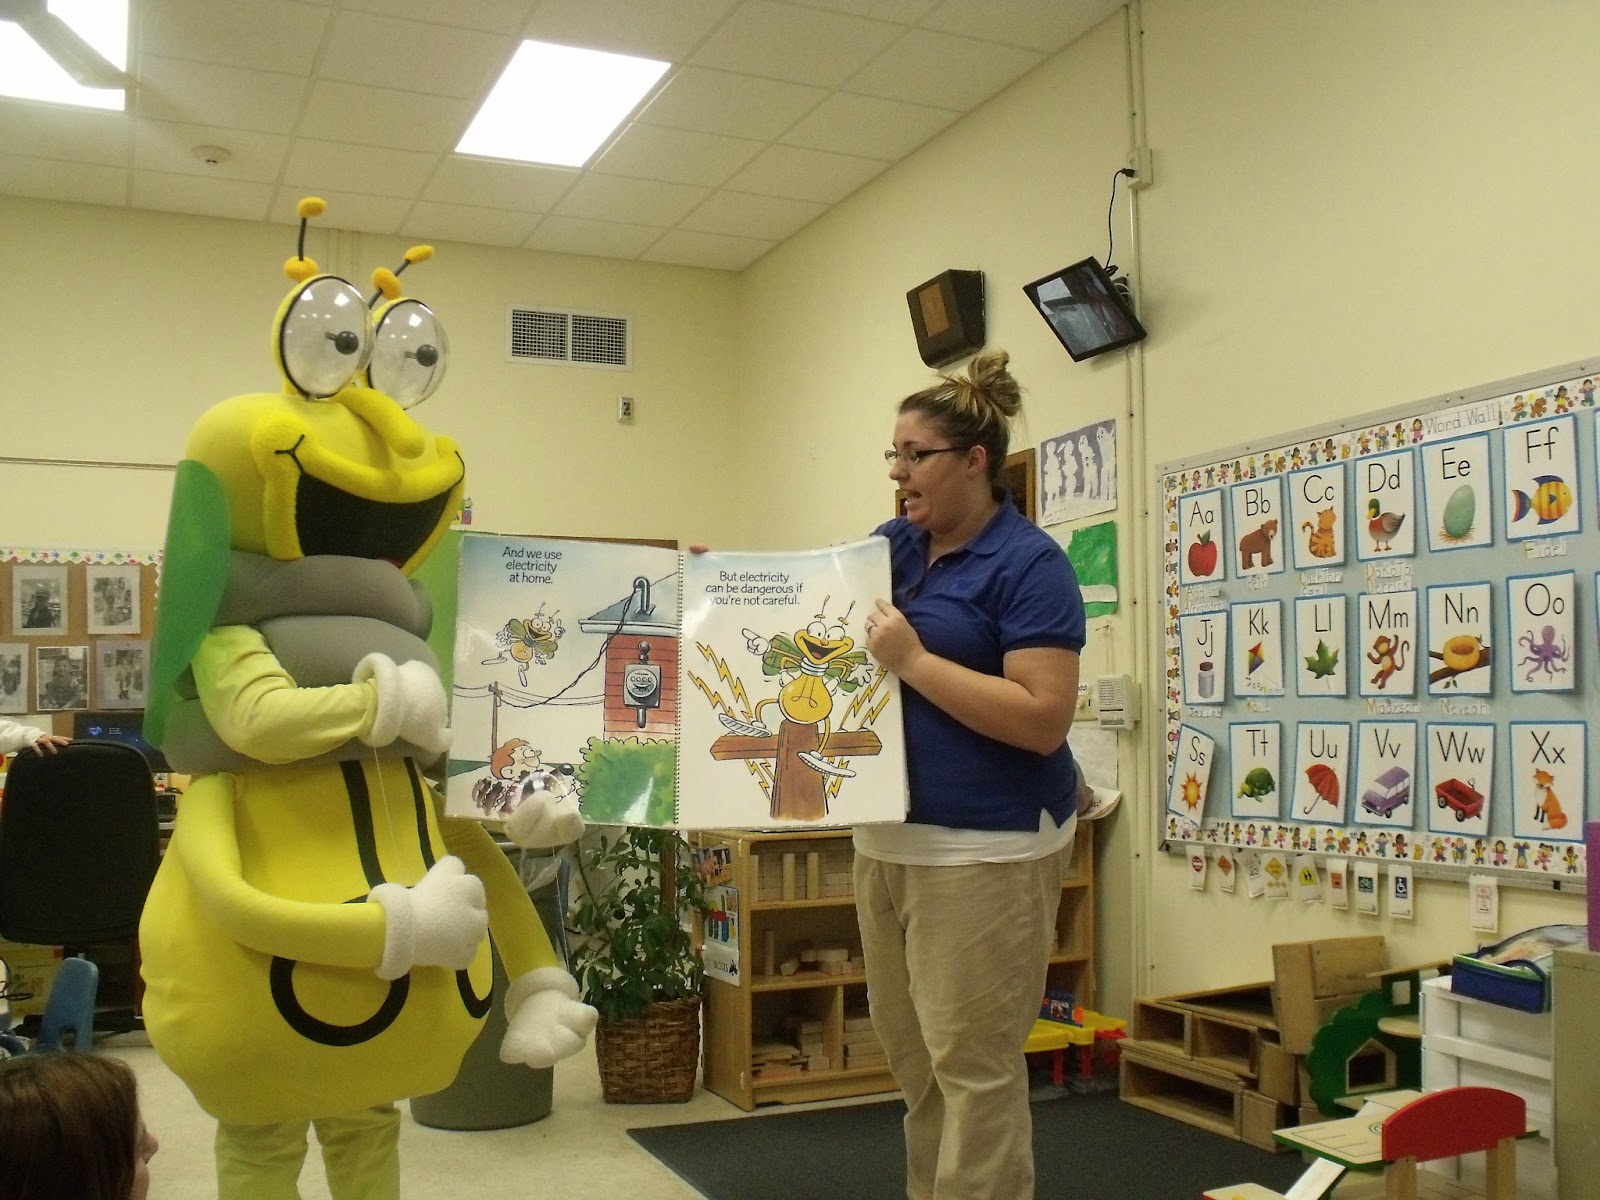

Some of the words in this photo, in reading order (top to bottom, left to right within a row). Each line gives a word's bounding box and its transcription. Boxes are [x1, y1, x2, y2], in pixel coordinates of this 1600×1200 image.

[1425, 412, 1461, 435] Word
[1466, 404, 1496, 426] Wall
[1526, 423, 1558, 463] Ff
[1442, 447, 1470, 479] Ee
[1304, 475, 1334, 503] Cc
[1369, 462, 1400, 493] Dd
[1190, 501, 1213, 527] Aa
[1246, 488, 1270, 516] Bb
[503, 546, 525, 558] And
[527, 550, 542, 559] we
[544, 551, 562, 560] use
[506, 560, 557, 574] electricity
[509, 573, 520, 583] at
[521, 572, 553, 584] home.
[705, 584, 724, 593] can
[726, 583, 739, 594] be
[740, 583, 794, 595] dangerous
[796, 582, 803, 593] if
[720, 570, 738, 582] But
[739, 571, 790, 584] electricity
[709, 594, 741, 606] you're
[743, 595, 760, 606] not
[762, 594, 800, 606] careful.
[1445, 593, 1478, 624] Nn
[1525, 583, 1564, 616] Oo
[1249, 608, 1269, 635] Kk
[1369, 599, 1408, 629] Mm
[1190, 733, 1208, 765] Ss
[1246, 730, 1268, 756] Tt
[1311, 730, 1337, 758] Uu
[1375, 729, 1400, 758] Vv
[1437, 731, 1485, 763] Ww
[1531, 731, 1565, 764] Xx
